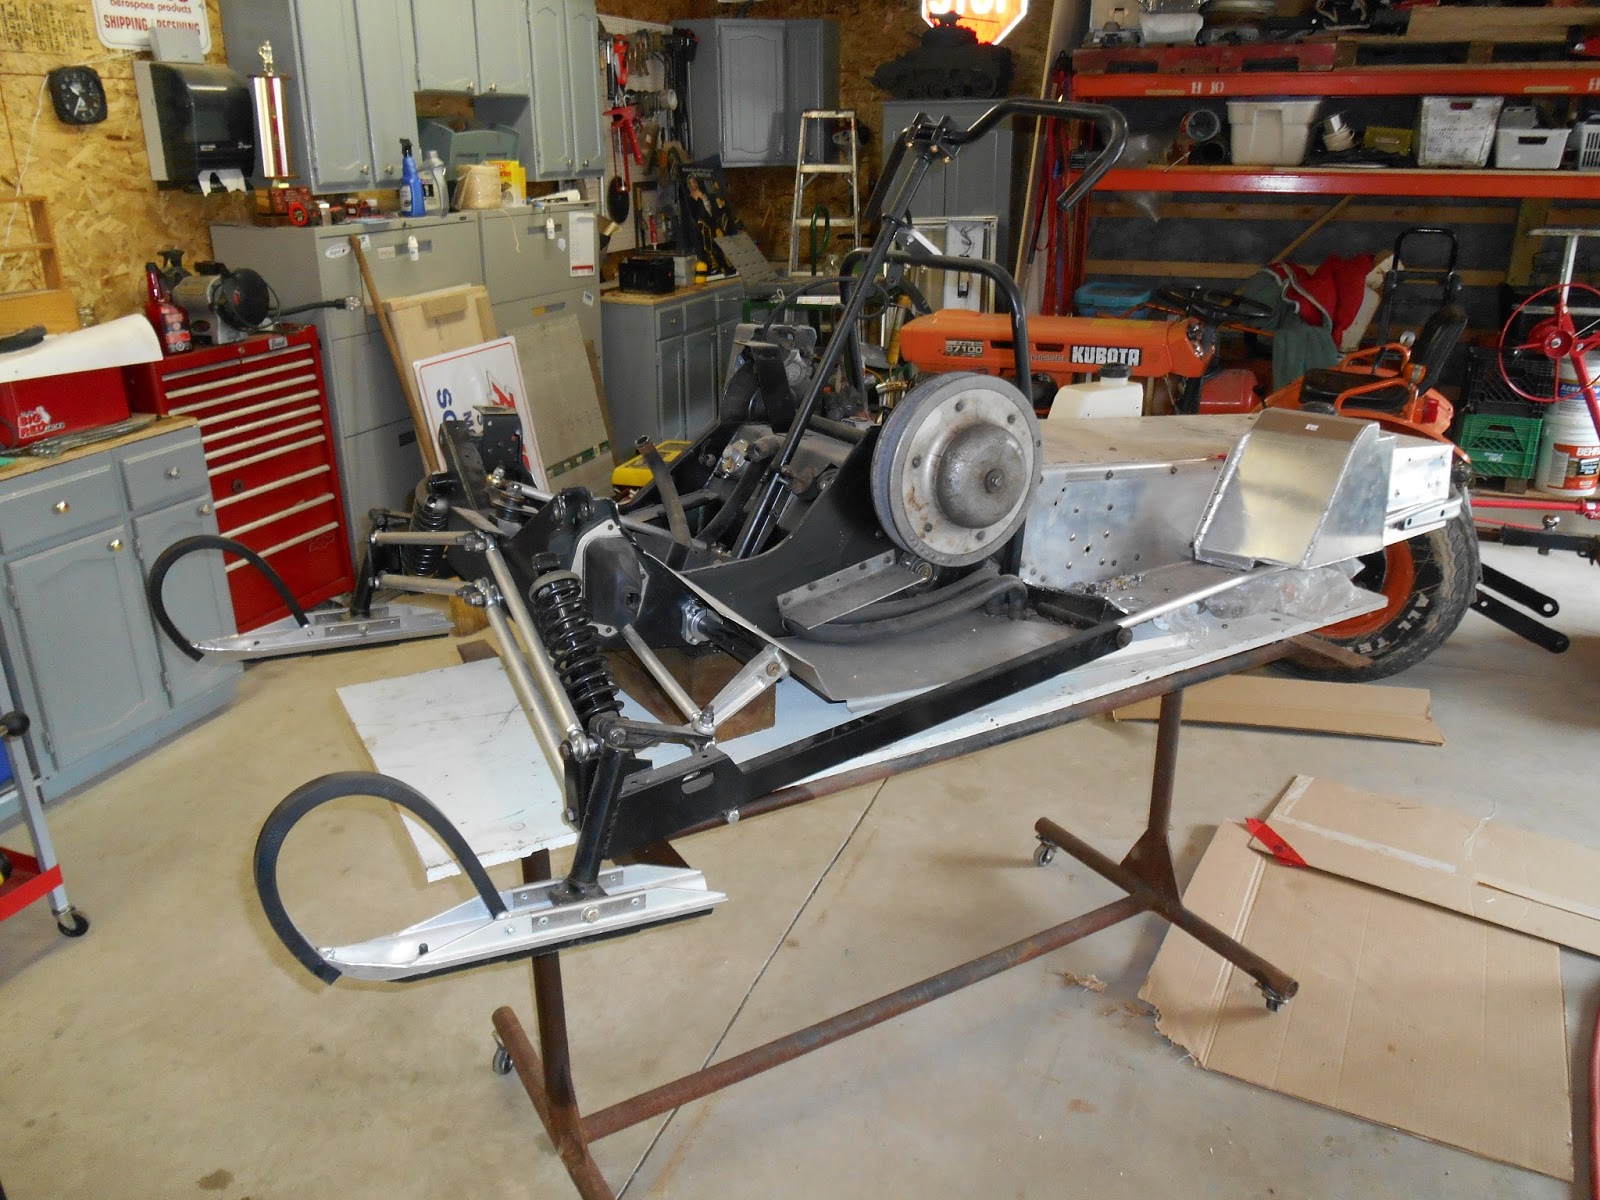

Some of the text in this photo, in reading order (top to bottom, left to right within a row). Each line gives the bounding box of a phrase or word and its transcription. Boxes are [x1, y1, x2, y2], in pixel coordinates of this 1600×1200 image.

[109, 0, 192, 14] aerospace products
[103, 14, 148, 32] SHIPPING
[1071, 345, 1140, 367] KUBOTA
[18, 413, 43, 428] BIG
